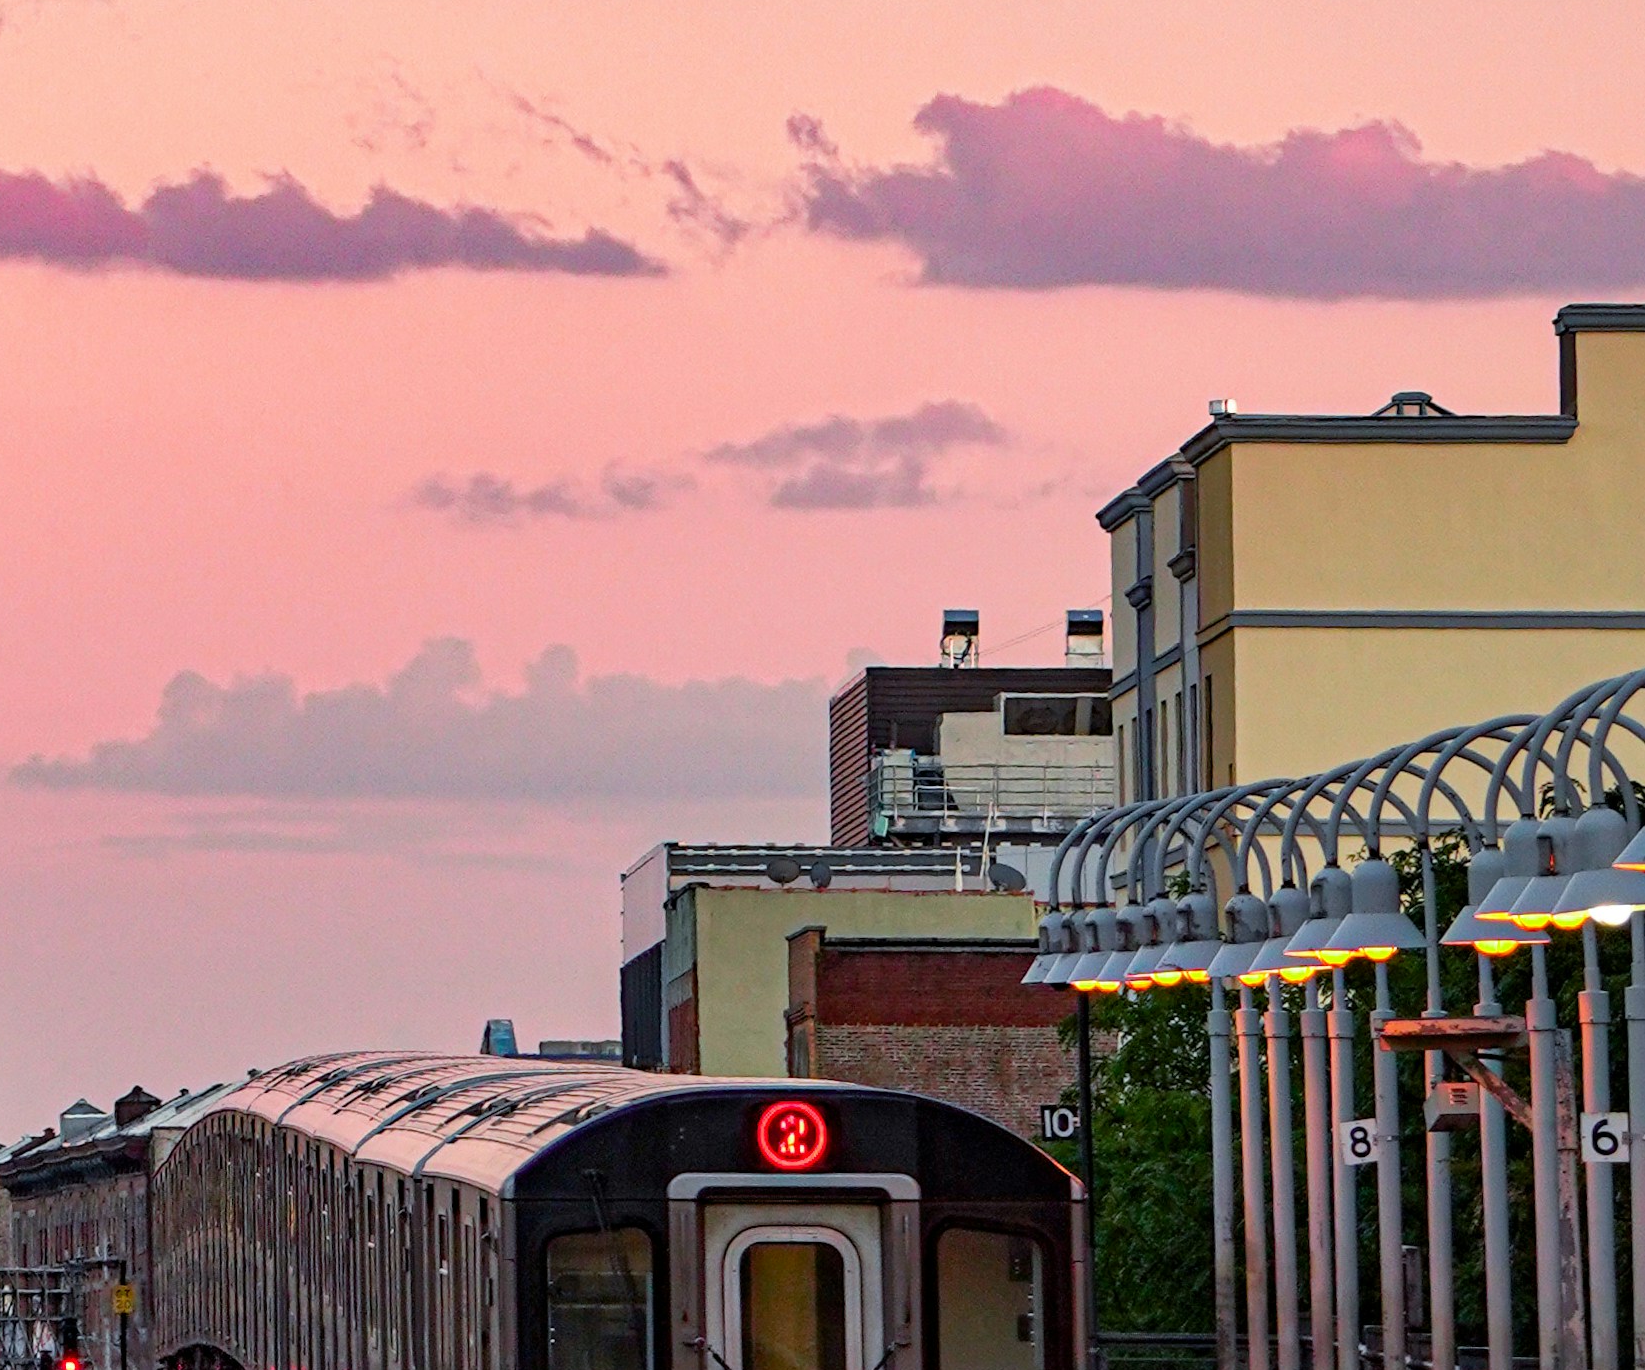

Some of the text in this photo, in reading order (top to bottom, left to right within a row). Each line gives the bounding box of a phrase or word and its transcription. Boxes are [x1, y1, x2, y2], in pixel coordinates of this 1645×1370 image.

[1044, 1108, 1075, 1137] 10
[1592, 1119, 1618, 1156] 6
[1350, 1126, 1371, 1158] 8
